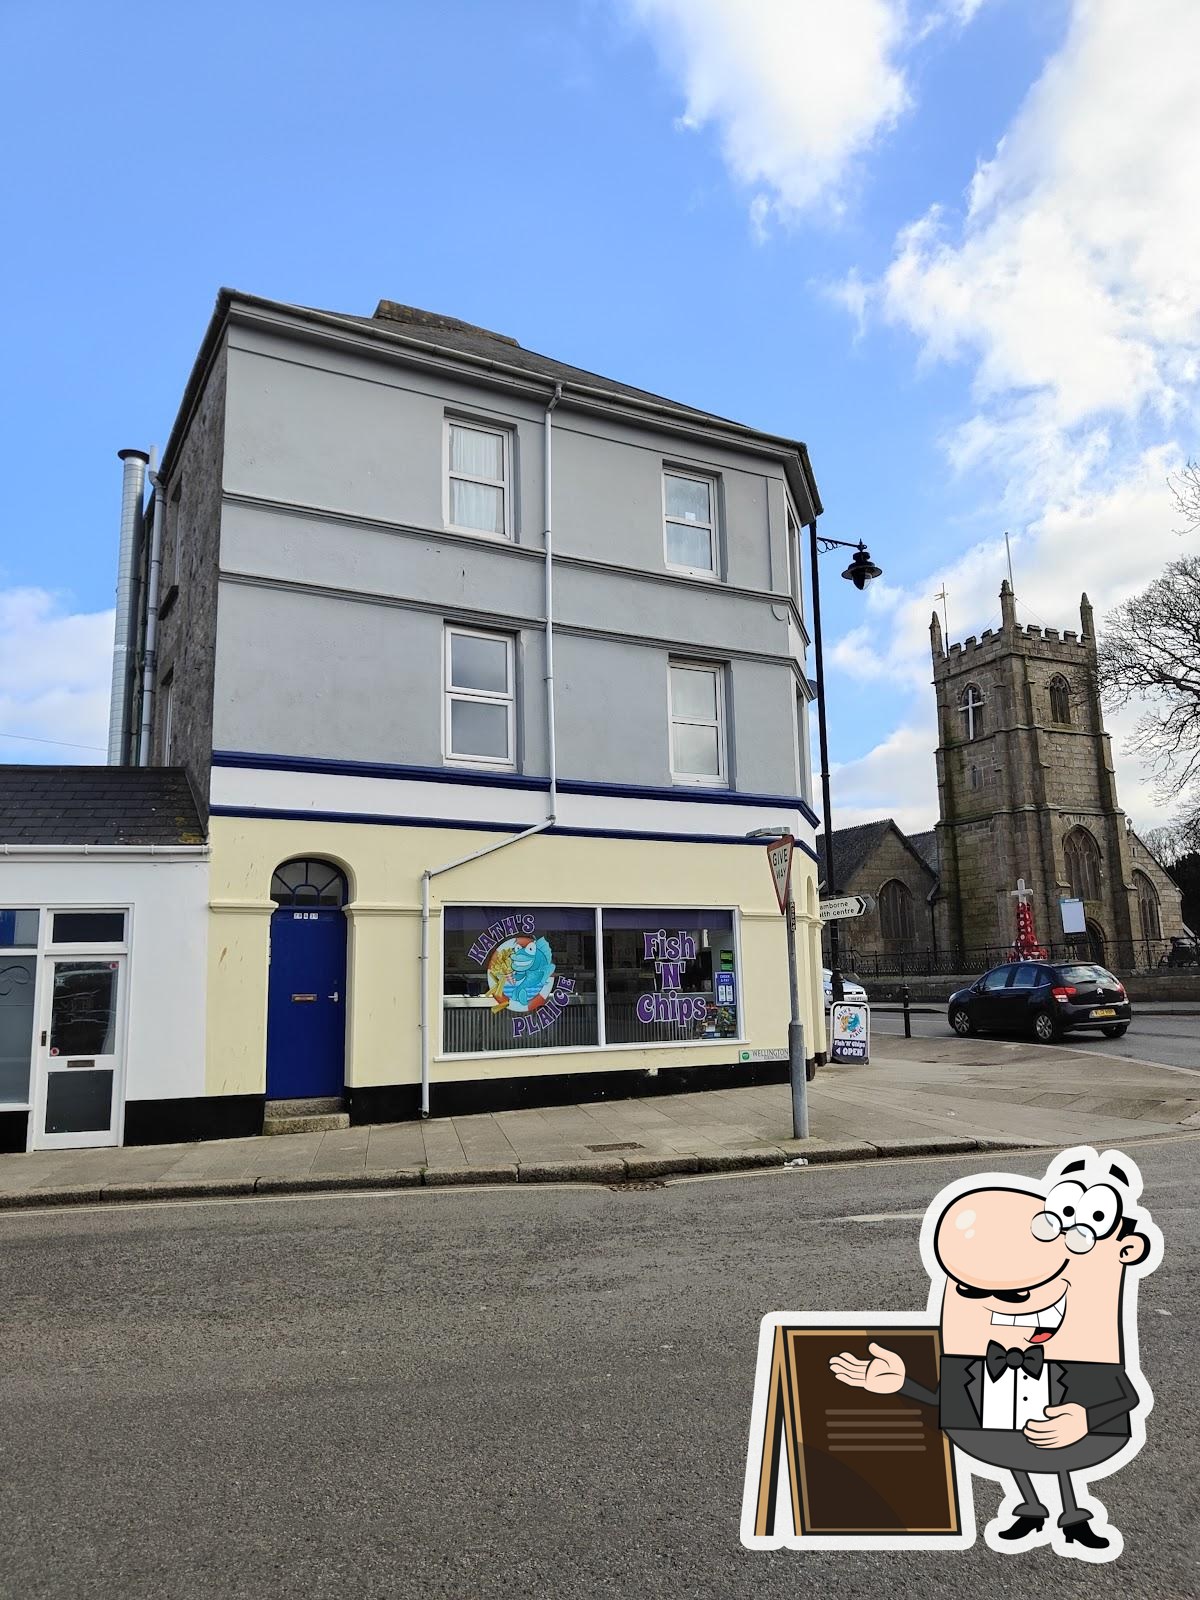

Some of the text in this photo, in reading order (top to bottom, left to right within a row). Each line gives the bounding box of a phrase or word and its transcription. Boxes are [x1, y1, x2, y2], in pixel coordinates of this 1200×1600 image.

[772, 848, 788, 867] GIVE
[776, 867, 787, 880] WAY
[819, 901, 849, 911] amborne
[819, 908, 855, 918] lth centre
[467, 914, 536, 966] KATH'S
[643, 929, 696, 960] Fish
[655, 961, 687, 990] 'N'
[511, 975, 576, 1038] PLAICE
[636, 990, 707, 1028] Chips
[752, 1048, 789, 1057] WELLINGTON
[842, 1047, 863, 1057] OPEN
